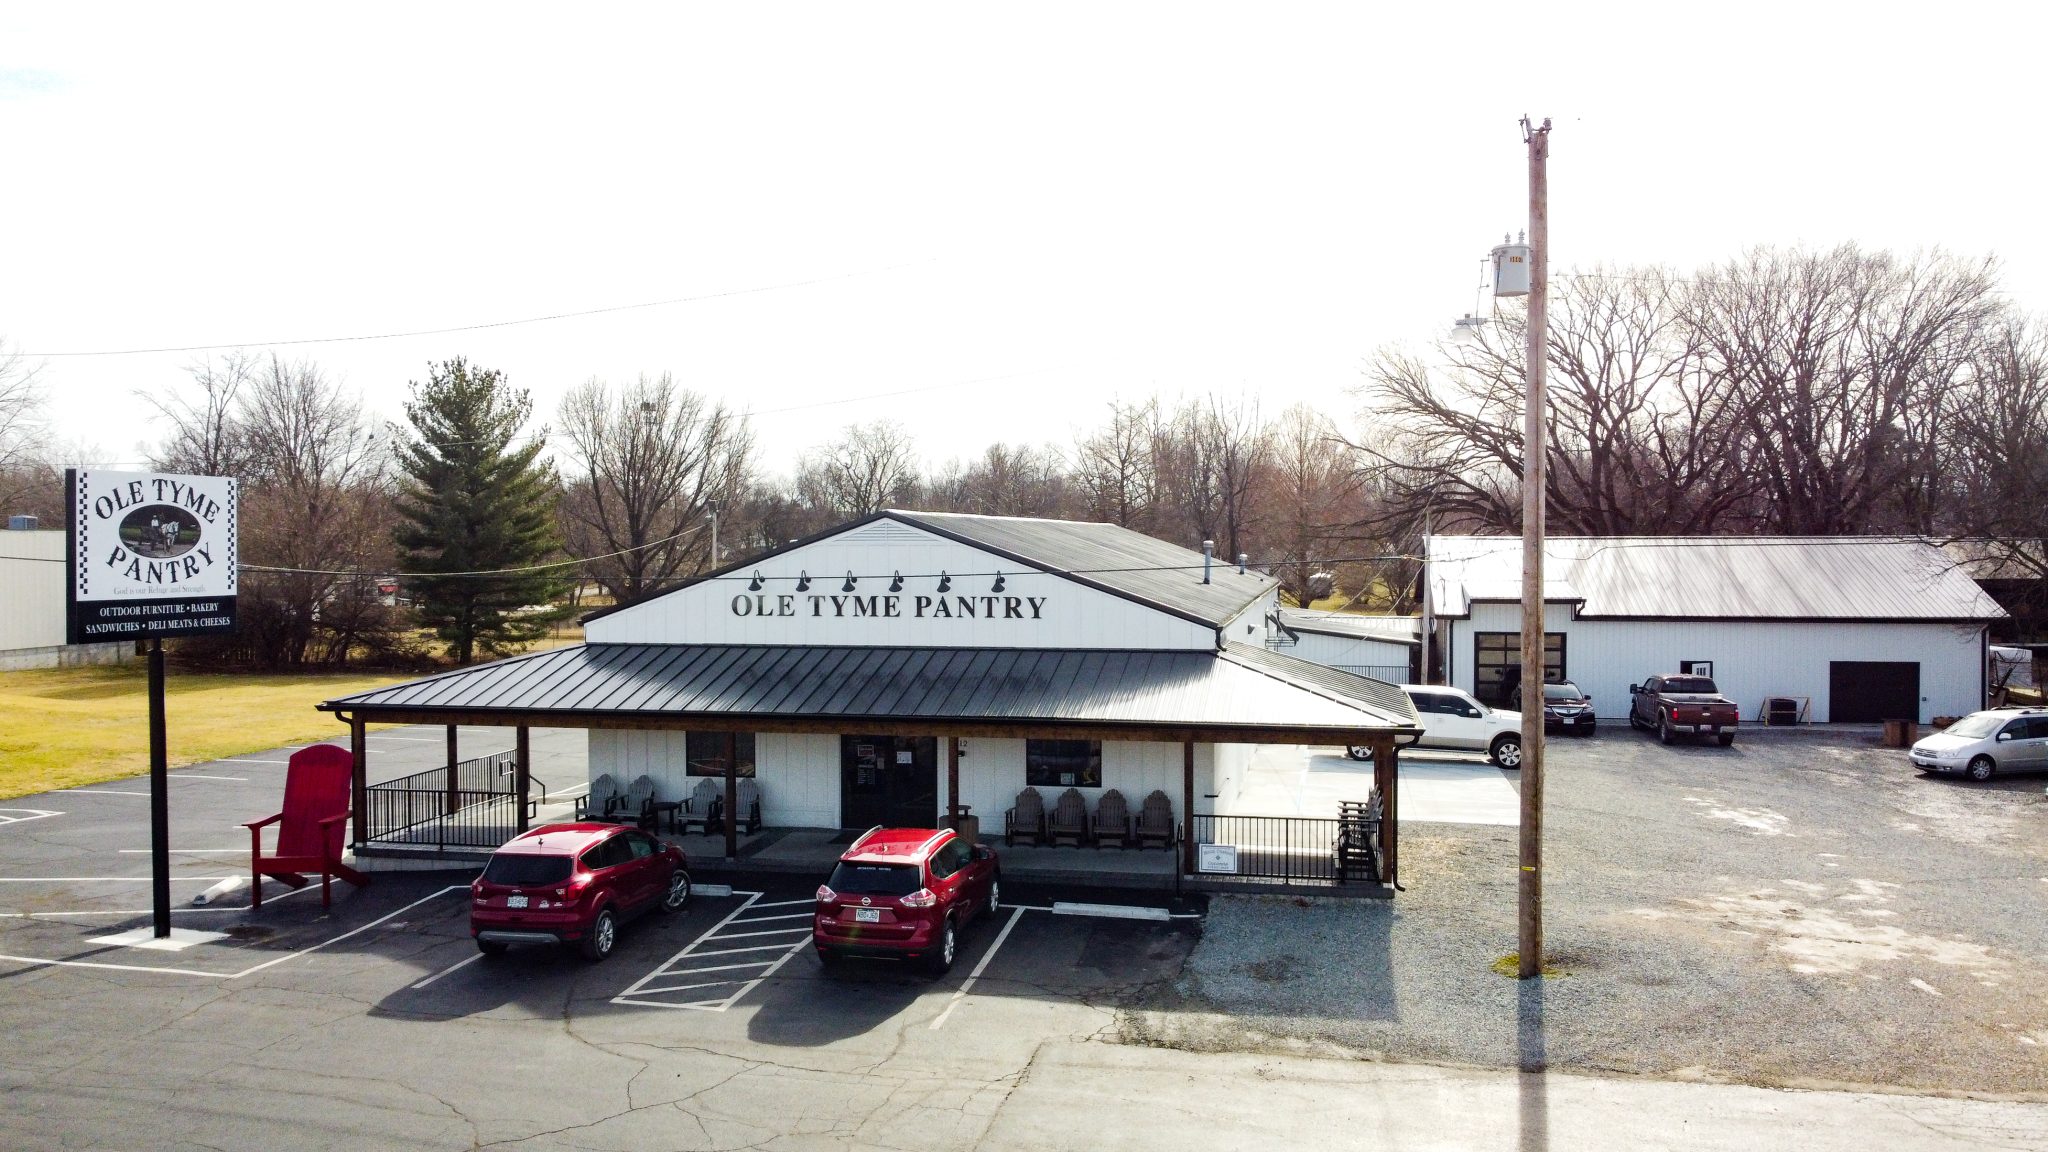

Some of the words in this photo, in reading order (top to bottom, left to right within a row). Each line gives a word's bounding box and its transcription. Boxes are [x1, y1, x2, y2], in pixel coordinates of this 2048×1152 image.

[95, 480, 144, 520] OLE
[152, 478, 220, 524] TYME
[106, 542, 214, 584] PANTRY
[100, 606, 140, 616] OUTDOOR
[142, 604, 185, 615] FURNITURE
[191, 602, 219, 612] BAKERY
[731, 594, 795, 617] OLE
[807, 594, 901, 618] TYME
[914, 595, 1047, 619] PANTRY
[86, 622, 140, 634] SANDWICHES
[148, 620, 166, 630] DELI
[168, 619, 192, 629] MEATS
[193, 619, 198, 627] &
[200, 616, 230, 627] CHEESES
